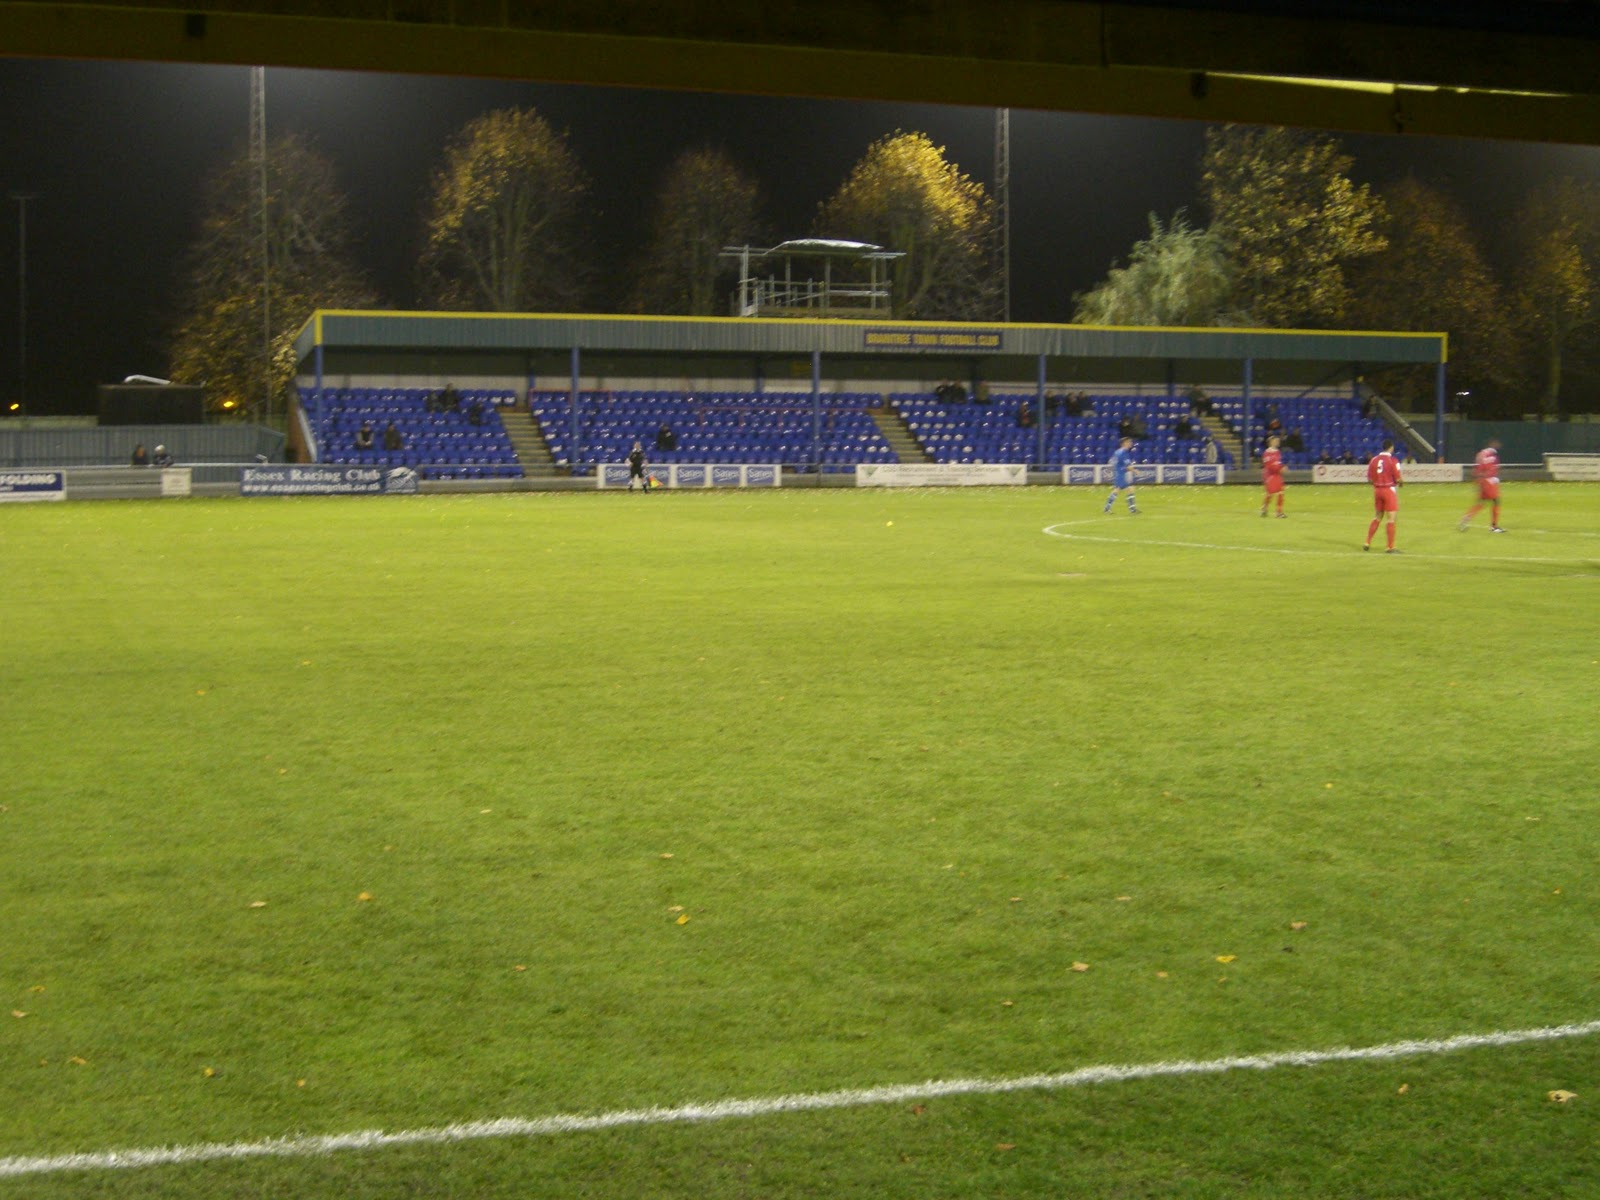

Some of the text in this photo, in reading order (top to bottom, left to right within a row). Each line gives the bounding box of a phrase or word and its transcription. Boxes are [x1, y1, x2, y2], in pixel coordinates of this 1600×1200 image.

[977, 335, 1000, 346] CLUB
[1376, 459, 1384, 474] 5
[243, 469, 381, 483] Essex Racing Club
